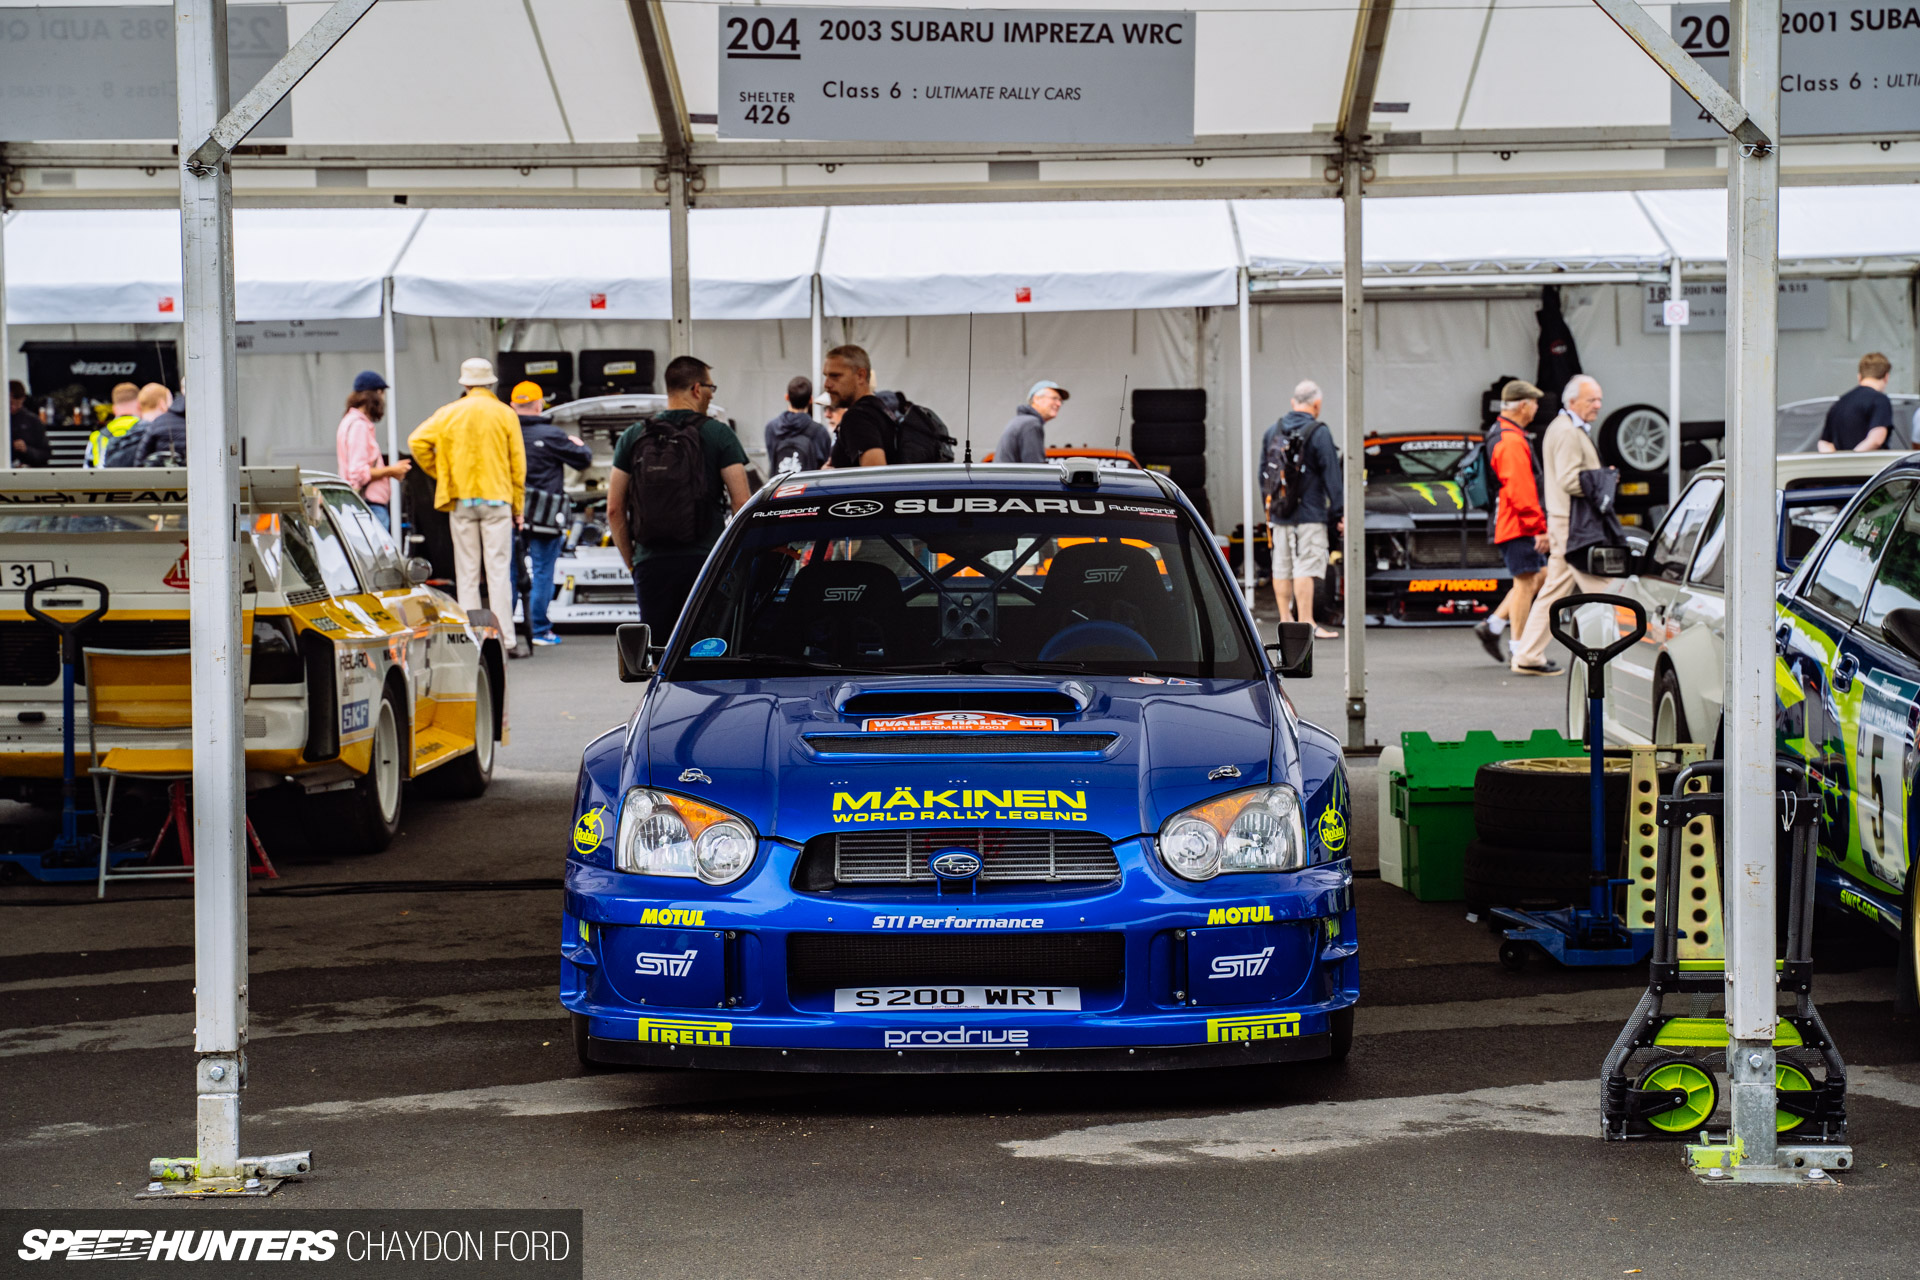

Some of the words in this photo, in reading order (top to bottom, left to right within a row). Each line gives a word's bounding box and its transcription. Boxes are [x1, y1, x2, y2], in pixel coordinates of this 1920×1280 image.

[820, 20, 882, 41] 2003
[890, 20, 994, 43] SUBARU
[1004, 22, 1115, 44] IMPREZA
[1122, 23, 1183, 45] WRC
[1782, 12, 1837, 34] 2001
[727, 17, 800, 51] 204
[822, 81, 880, 98] Class
[890, 82, 902, 99] 6
[926, 85, 995, 99] ULTIMATE
[999, 87, 1040, 100] RALLY
[1044, 87, 1082, 101] CARS
[1780, 74, 1839, 92] Class
[1849, 72, 1862, 90] 6
[739, 92, 796, 103] SHELTER
[744, 105, 790, 124] 426
[775, 484, 803, 498] 2
[894, 498, 1106, 515] SUBARU
[1408, 578, 1498, 593] DRIFTWORKS
[343, 702, 369, 730] SKF
[832, 787, 1087, 809] MÄKINEN
[833, 811, 915, 823] WORLD
[920, 811, 990, 820] RALLY
[996, 811, 1088, 822] LEGEND
[576, 827, 598, 844] Robin
[1323, 826, 1345, 842] Robin
[1206, 905, 1274, 925] MOTUL
[1840, 889, 1880, 923] swrt.com
[640, 908, 705, 926] MOTUL
[872, 915, 905, 929] STI
[908, 915, 1044, 929] Performance
[855, 988, 965, 1007] S200
[984, 989, 1062, 1006] WRT
[638, 1017, 733, 1046] PIRELLI
[885, 1025, 1029, 1048] prodrive
[1206, 1012, 1302, 1043] PIRELLI
